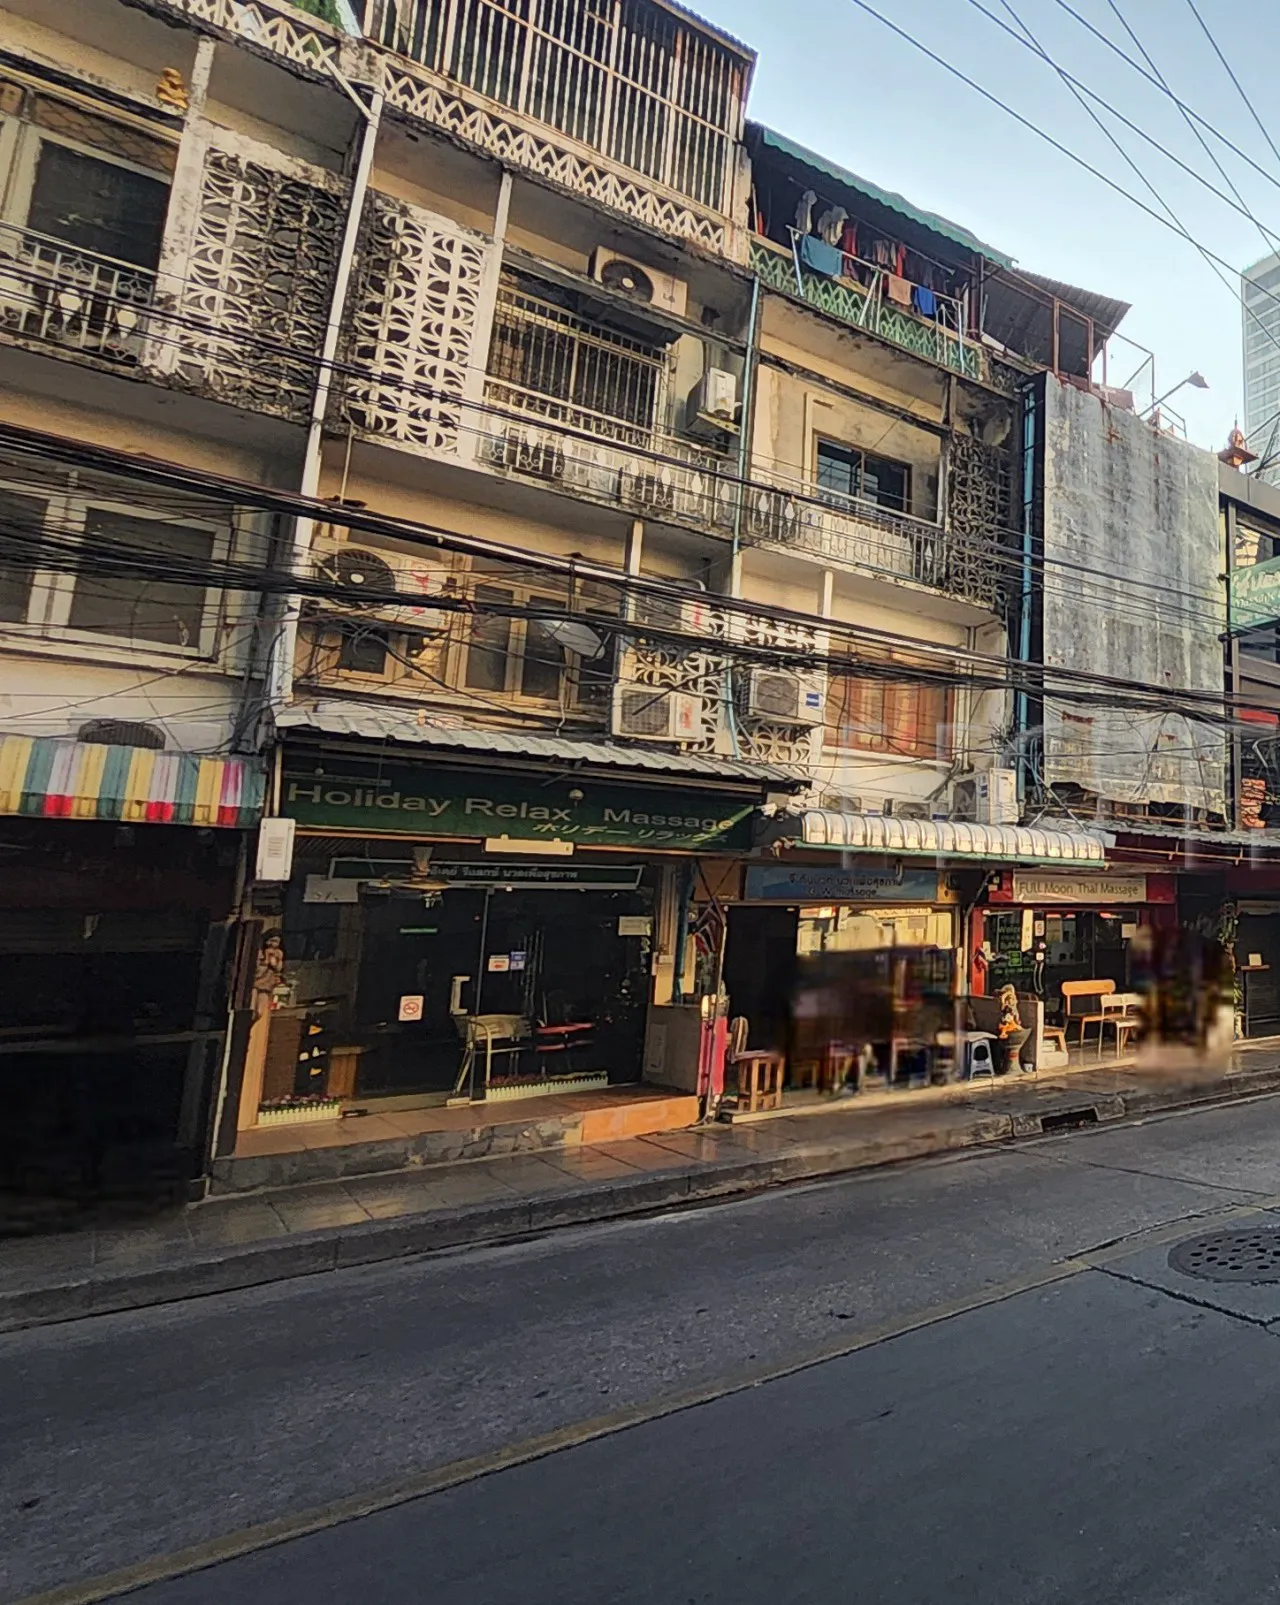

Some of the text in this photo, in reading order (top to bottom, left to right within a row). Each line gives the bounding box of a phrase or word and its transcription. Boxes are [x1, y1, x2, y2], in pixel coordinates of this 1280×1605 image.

[287, 782, 735, 832] Holiday Relax Massage
[1044, 882, 1074, 894] Moon
[1077, 882, 1098, 893] Thai
[1101, 882, 1139, 897] Massage
